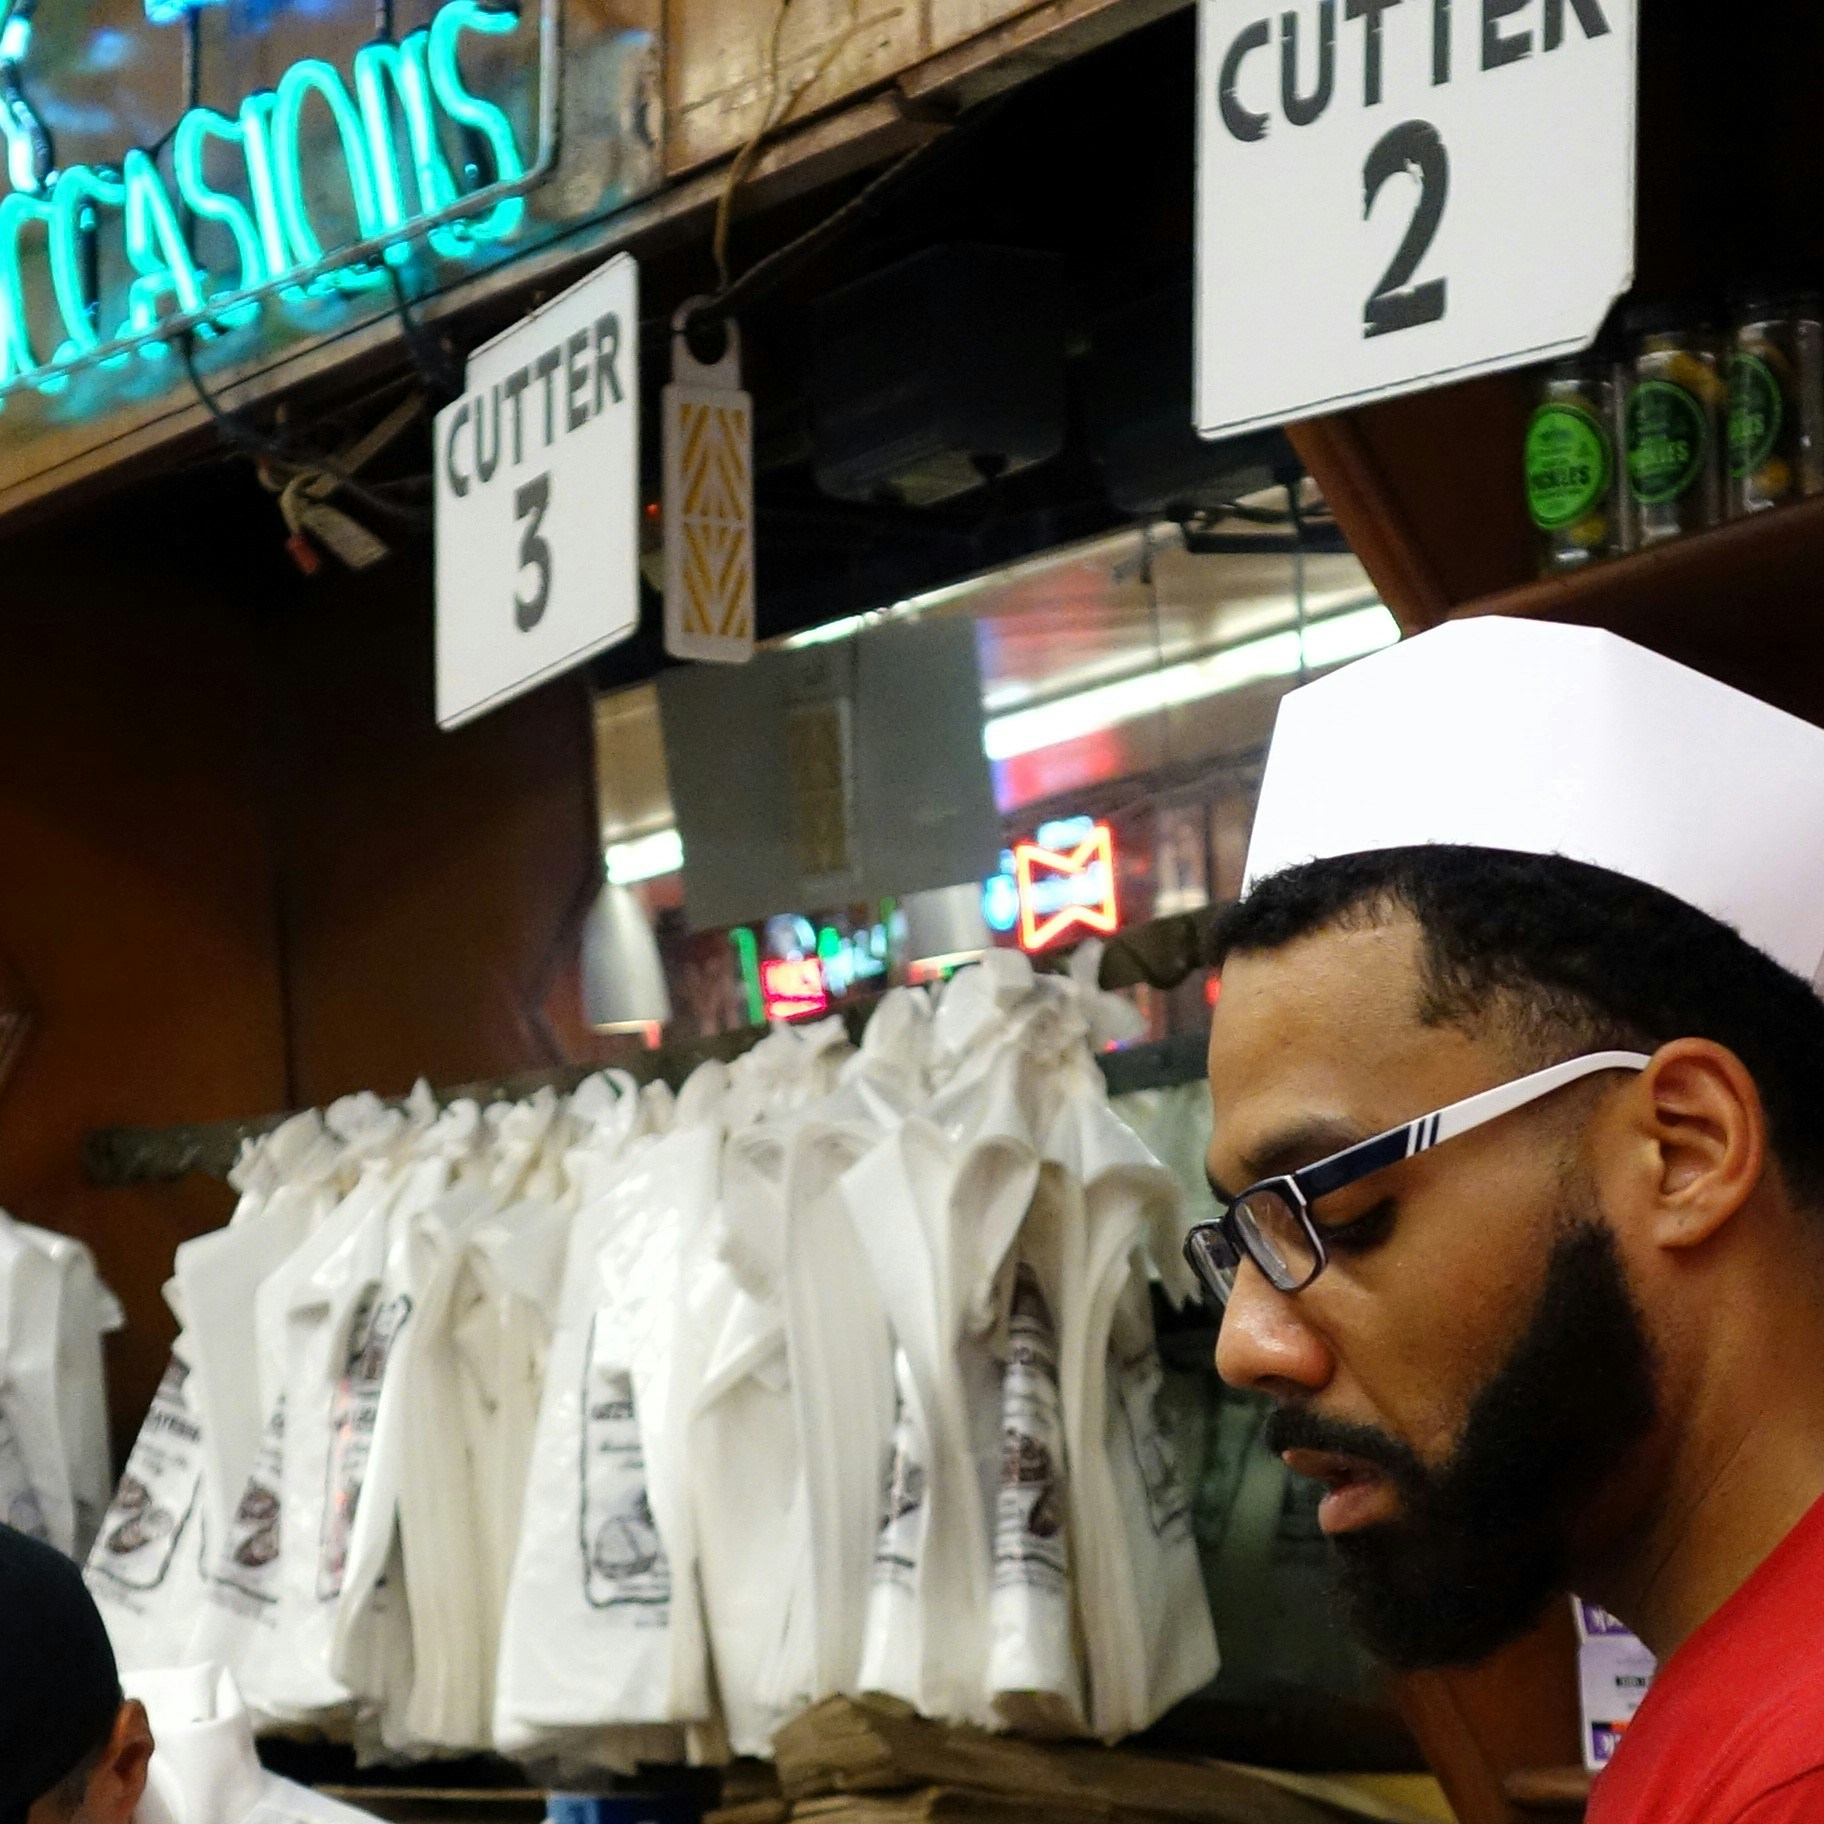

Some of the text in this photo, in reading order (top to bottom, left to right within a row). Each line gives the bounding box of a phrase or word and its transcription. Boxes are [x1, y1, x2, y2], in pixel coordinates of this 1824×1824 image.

[1361, 118, 1450, 339] 2
[445, 311, 624, 498] CUTTER
[514, 470, 553, 633] 3
